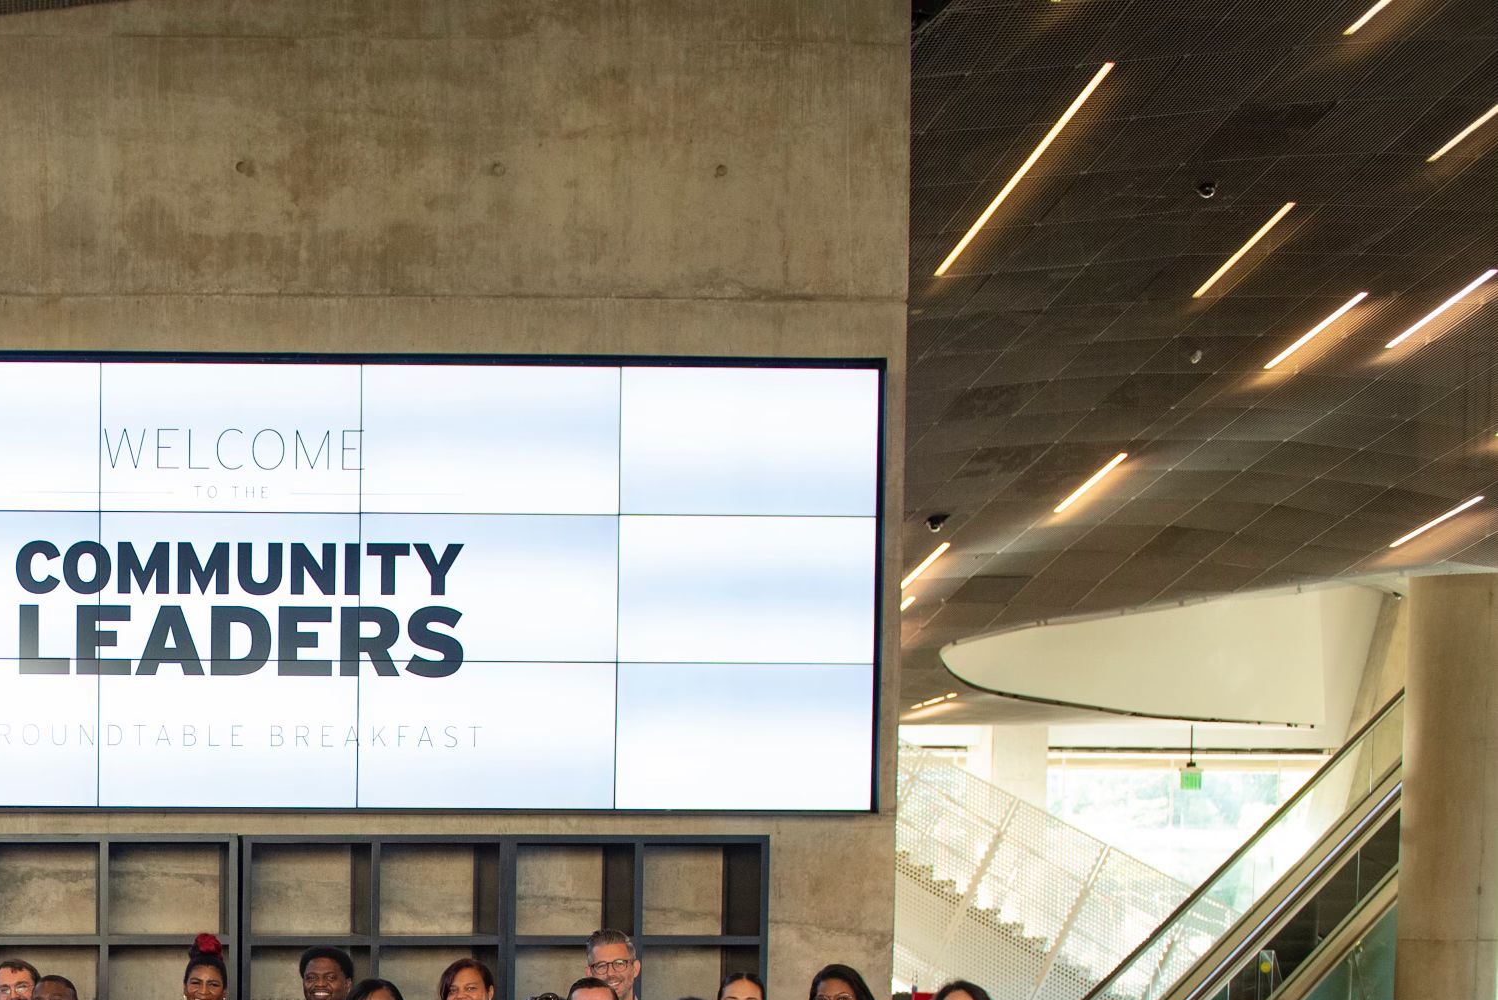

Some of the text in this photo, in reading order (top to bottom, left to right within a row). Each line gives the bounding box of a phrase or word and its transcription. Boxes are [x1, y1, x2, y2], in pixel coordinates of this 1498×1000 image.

[103, 427, 365, 471] WELCOME
[193, 485, 269, 499] TO THE
[15, 539, 465, 596] COMMUNITY
[18, 603, 464, 679] LEADERS
[269, 725, 482, 749] BREAKFAST
